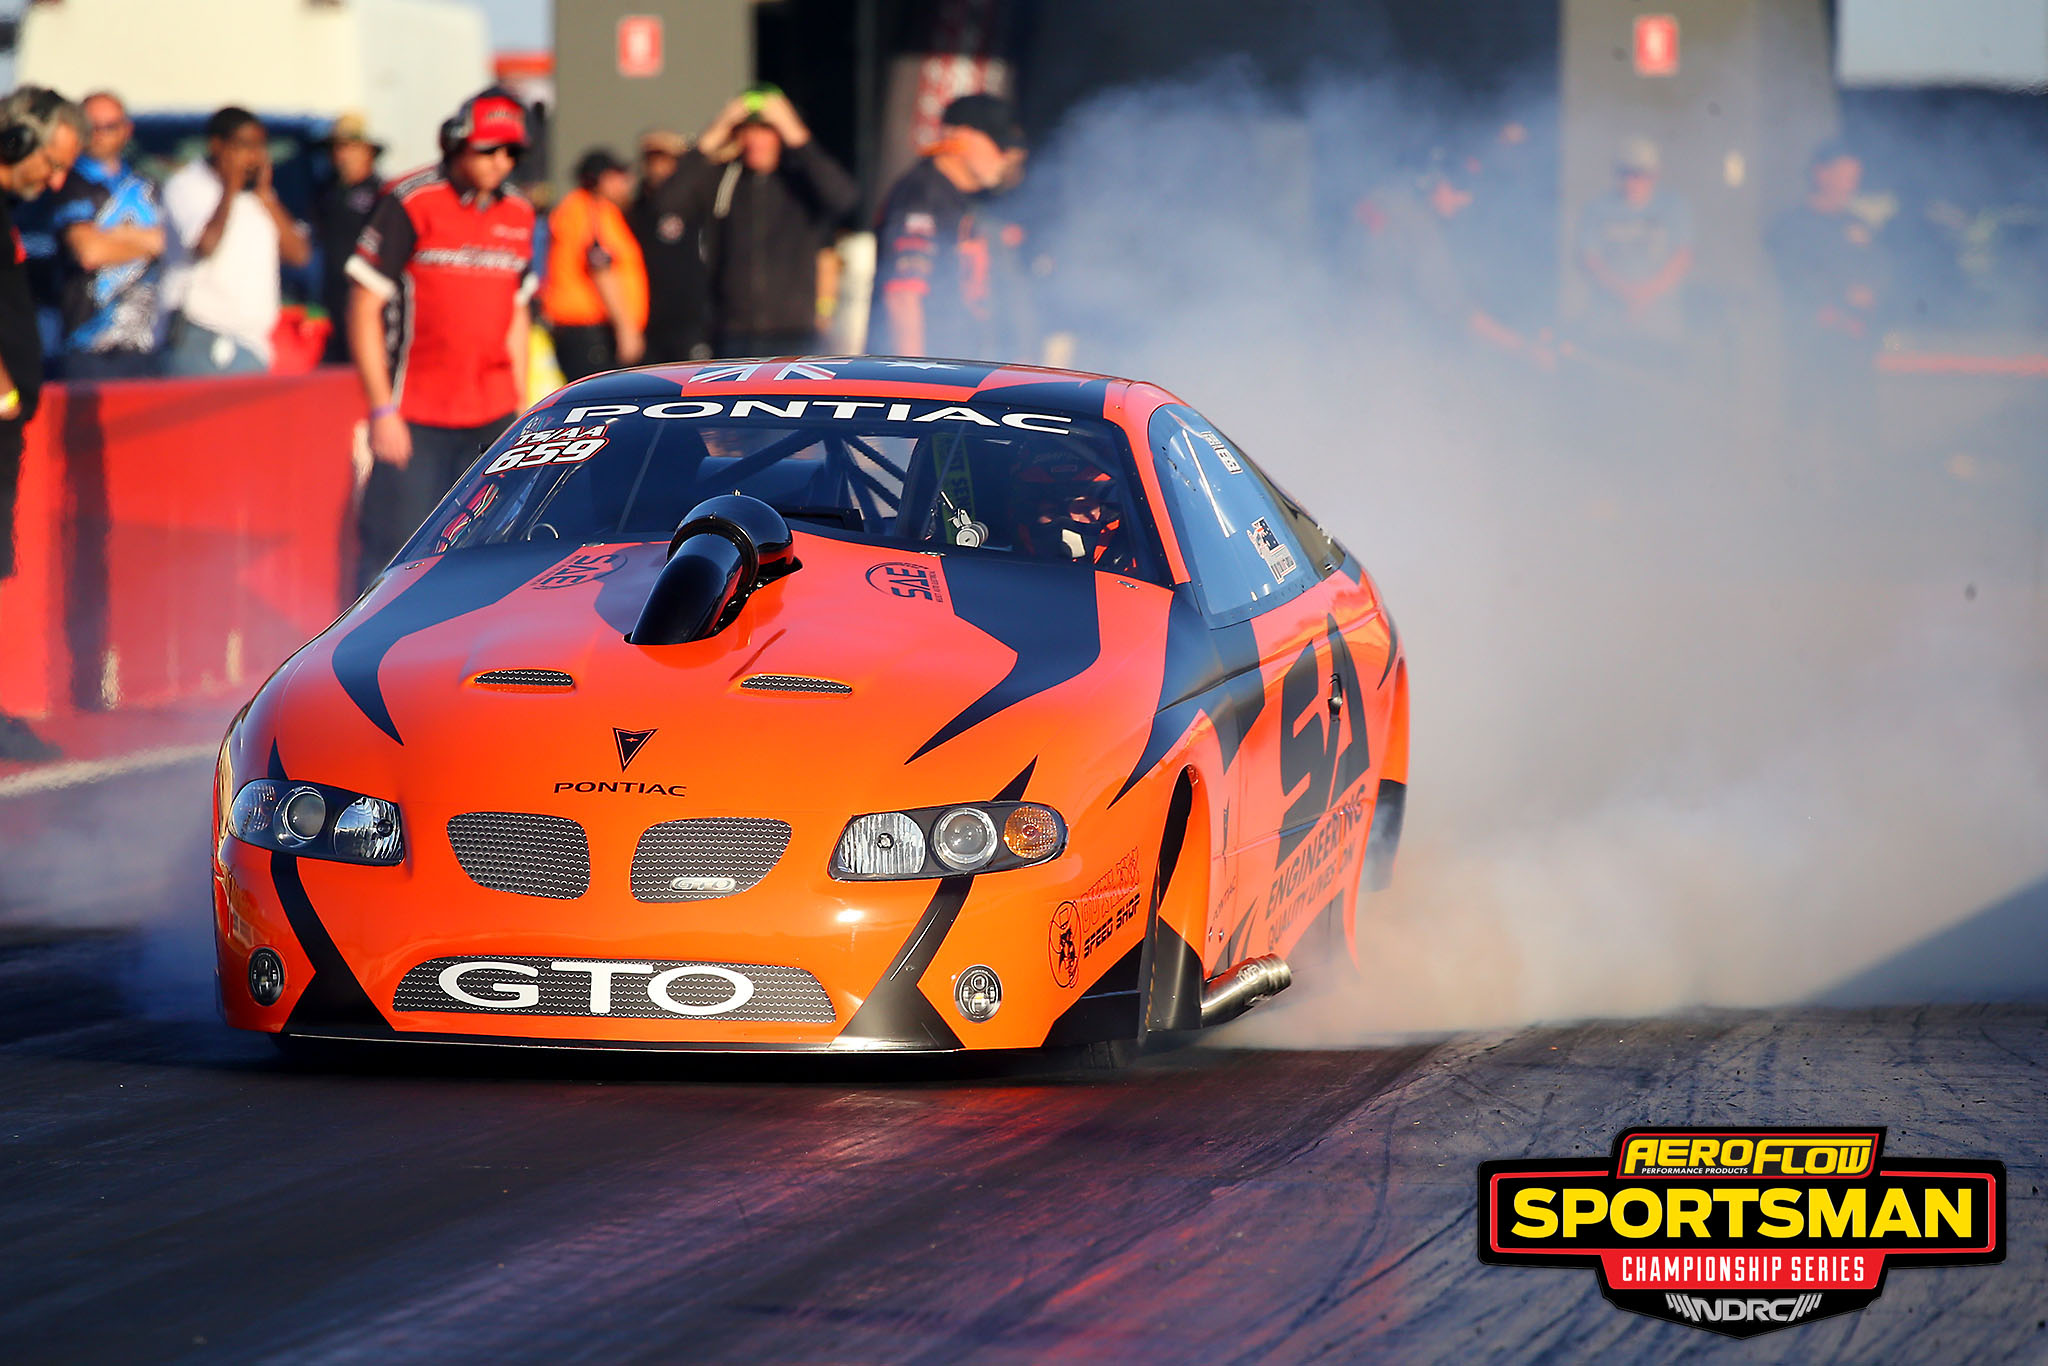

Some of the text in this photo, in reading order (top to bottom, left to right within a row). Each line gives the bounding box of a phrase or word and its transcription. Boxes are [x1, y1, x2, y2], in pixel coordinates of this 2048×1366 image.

[514, 425, 605, 446] TS/AA
[563, 403, 1071, 435] PONTIAC
[484, 438, 607, 475] 659
[885, 566, 933, 601] SAE
[554, 782, 686, 797] PONTIAC
[1265, 783, 1366, 921] ENGINEERING
[673, 880, 733, 891] GTO
[1083, 892, 1140, 960] SPEED SHOP
[1268, 891, 1306, 951] QUALITY
[439, 961, 755, 1017] GTO
